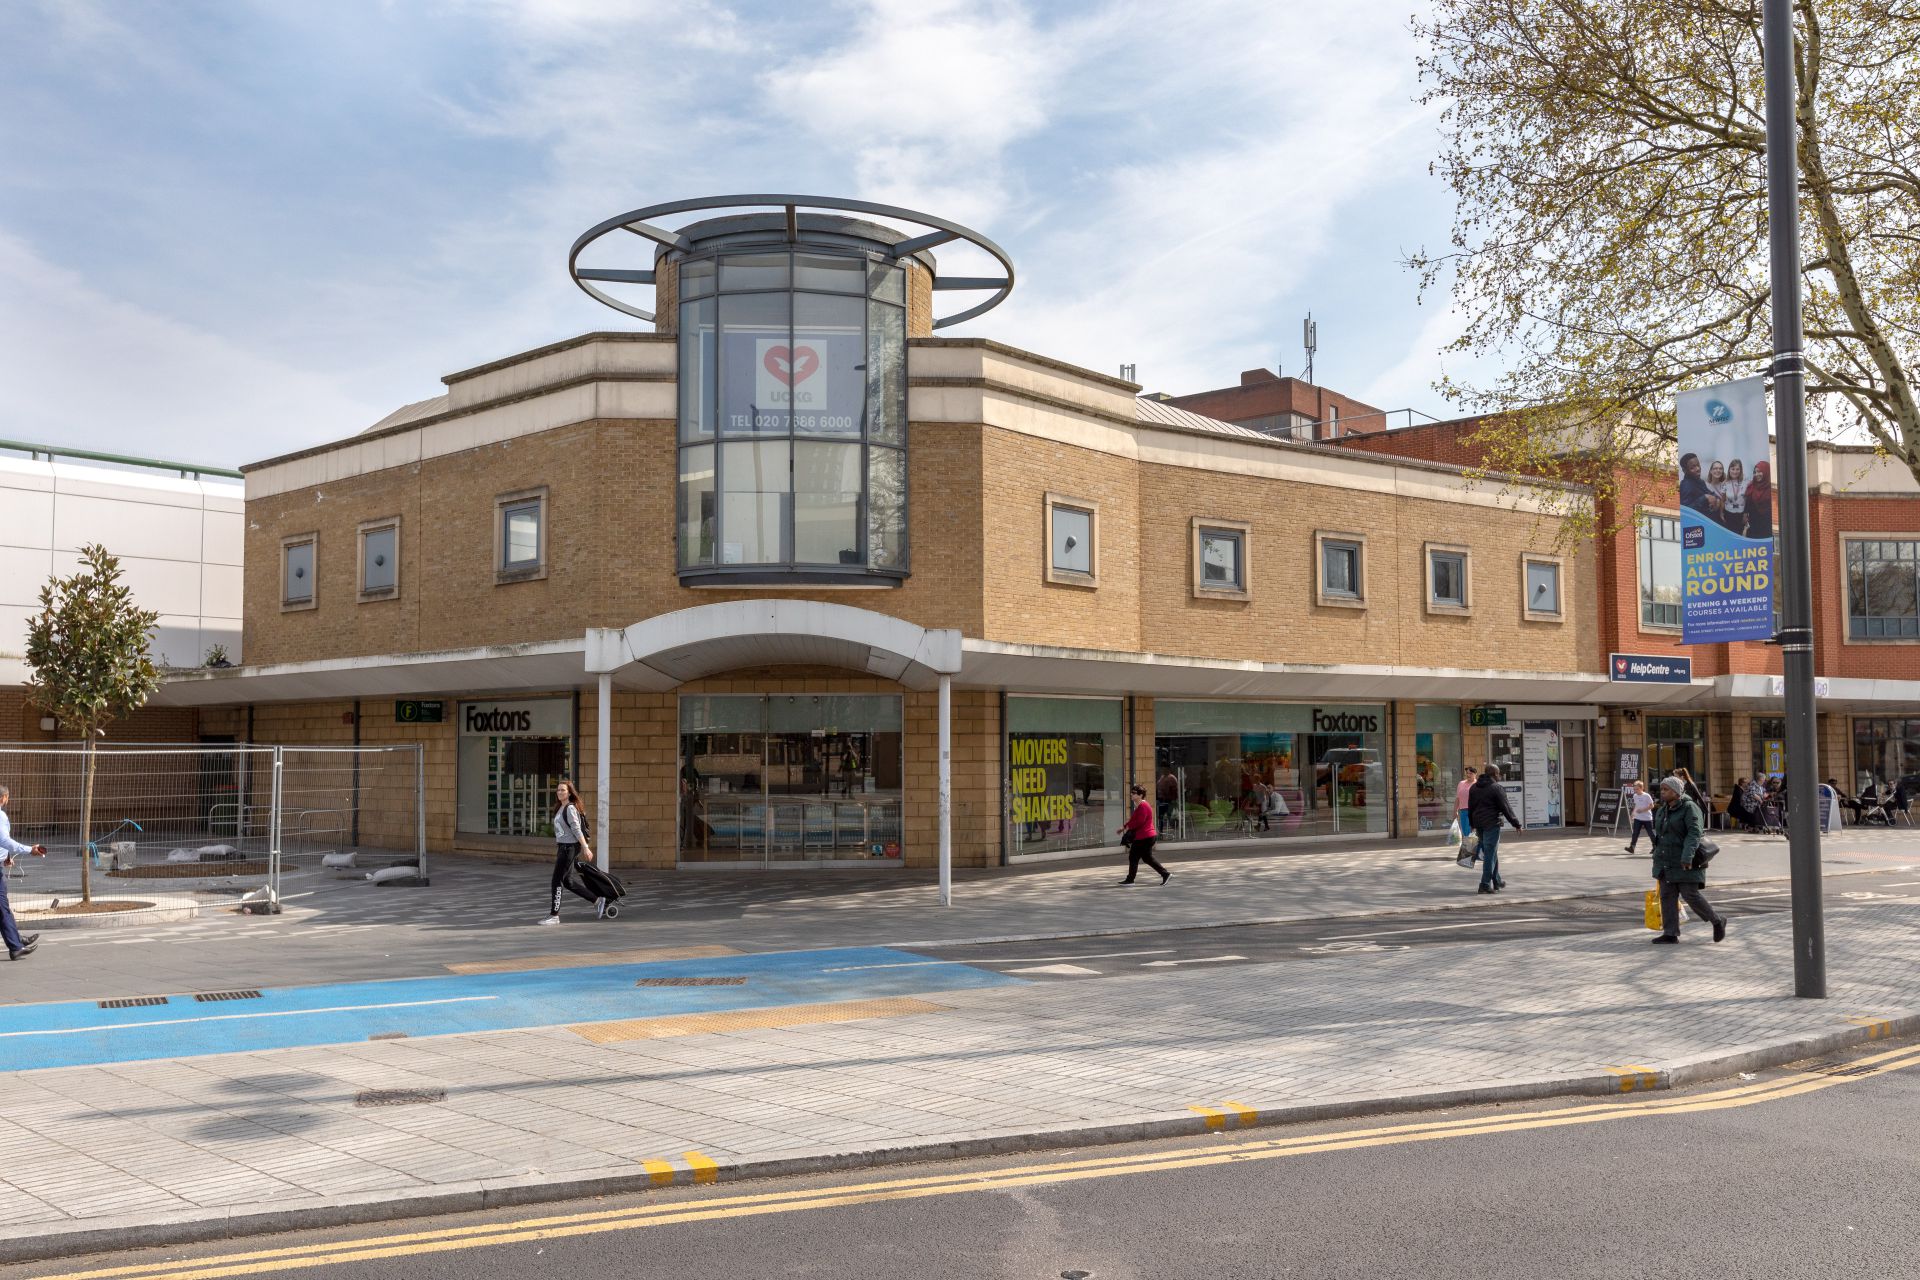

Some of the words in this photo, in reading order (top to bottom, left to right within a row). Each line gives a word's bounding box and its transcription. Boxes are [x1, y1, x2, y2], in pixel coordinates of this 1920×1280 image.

[731, 415, 751, 426] TEL
[755, 415, 779, 427] 020
[820, 416, 852, 428] 6000
[1687, 546, 1768, 565] ENROLLING
[1687, 565, 1717, 579] ALL
[1723, 559, 1768, 575] YEAR
[1686, 573, 1769, 597] ROUND
[1687, 600, 1720, 609] EVENING
[1729, 596, 1768, 605] WEEKEND
[1687, 608, 1722, 617] COURSES
[1724, 604, 1768, 614] AVAILABLE
[1630, 662, 1670, 676] HelpCentre
[466, 705, 531, 732] Foxtons
[1312, 708, 1378, 732] Foxtons
[1012, 738, 1067, 765] MOVERS
[1620, 760, 1638, 768] REALLY
[1012, 767, 1046, 795] NEED
[1012, 794, 1073, 823] SHAKERS
[554, 886, 562, 911] adidas
